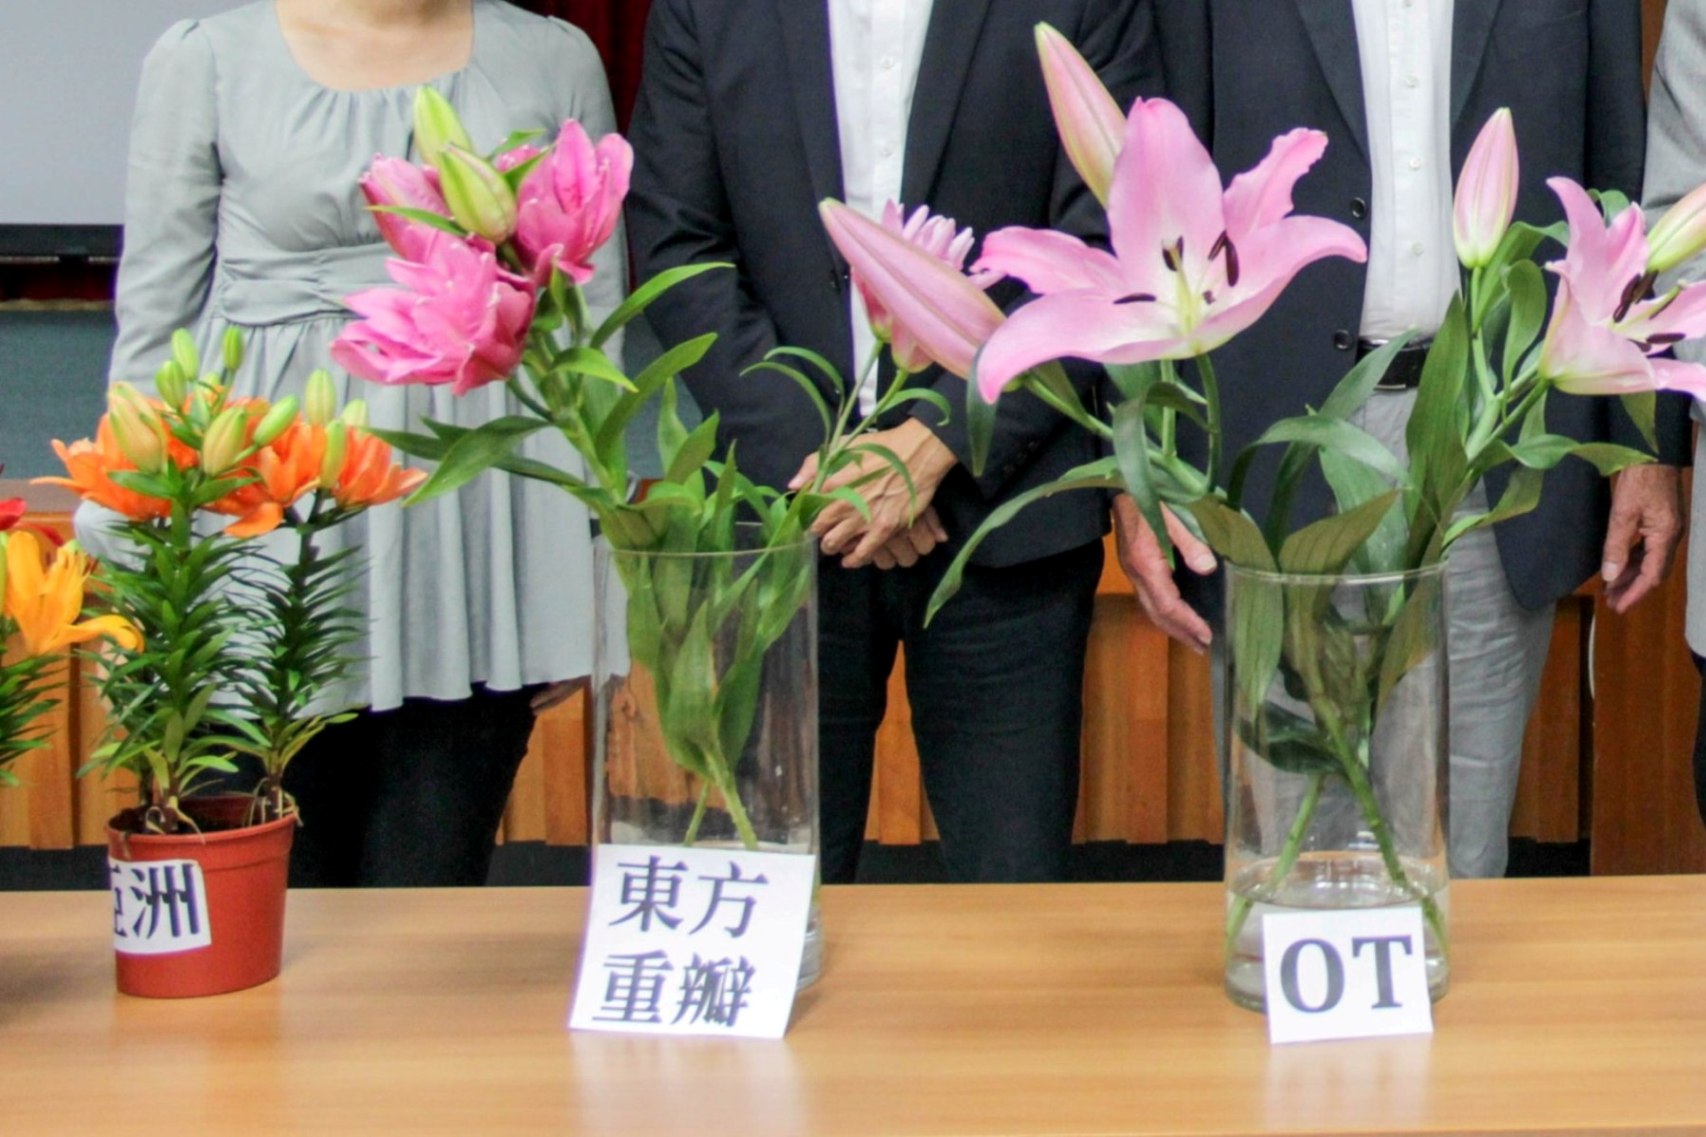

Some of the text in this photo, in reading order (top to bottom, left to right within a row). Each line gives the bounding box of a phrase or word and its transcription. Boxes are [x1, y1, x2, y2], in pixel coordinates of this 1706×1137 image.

[608, 855, 769, 938] 東方
[592, 950, 756, 1027] 重瓣
[1280, 934, 1413, 1013] OT
